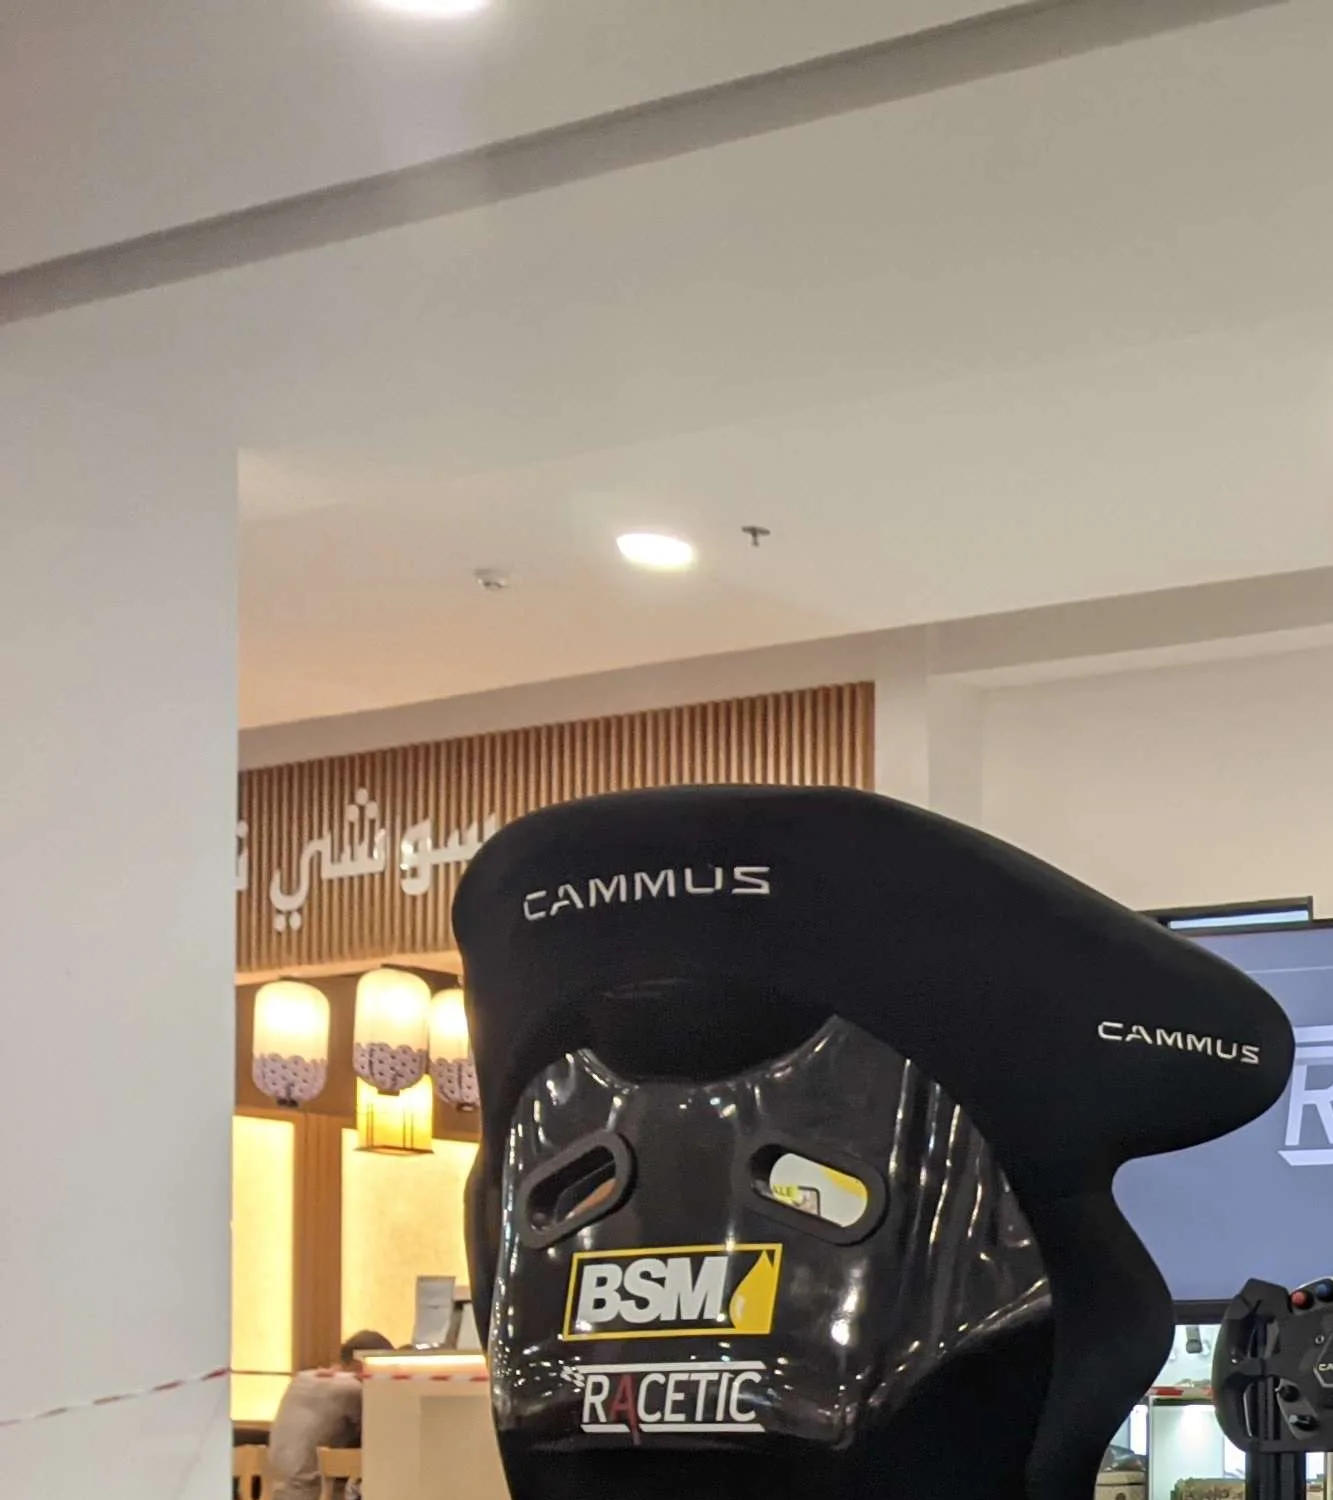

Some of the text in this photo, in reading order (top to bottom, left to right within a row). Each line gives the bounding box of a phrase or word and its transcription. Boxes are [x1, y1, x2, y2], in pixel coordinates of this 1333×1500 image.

[523, 865, 771, 922] CAMMUS
[1097, 1020, 1261, 1065] CAMMUS
[576, 1255, 729, 1324] BSM
[582, 1370, 763, 1445] RACETIC
